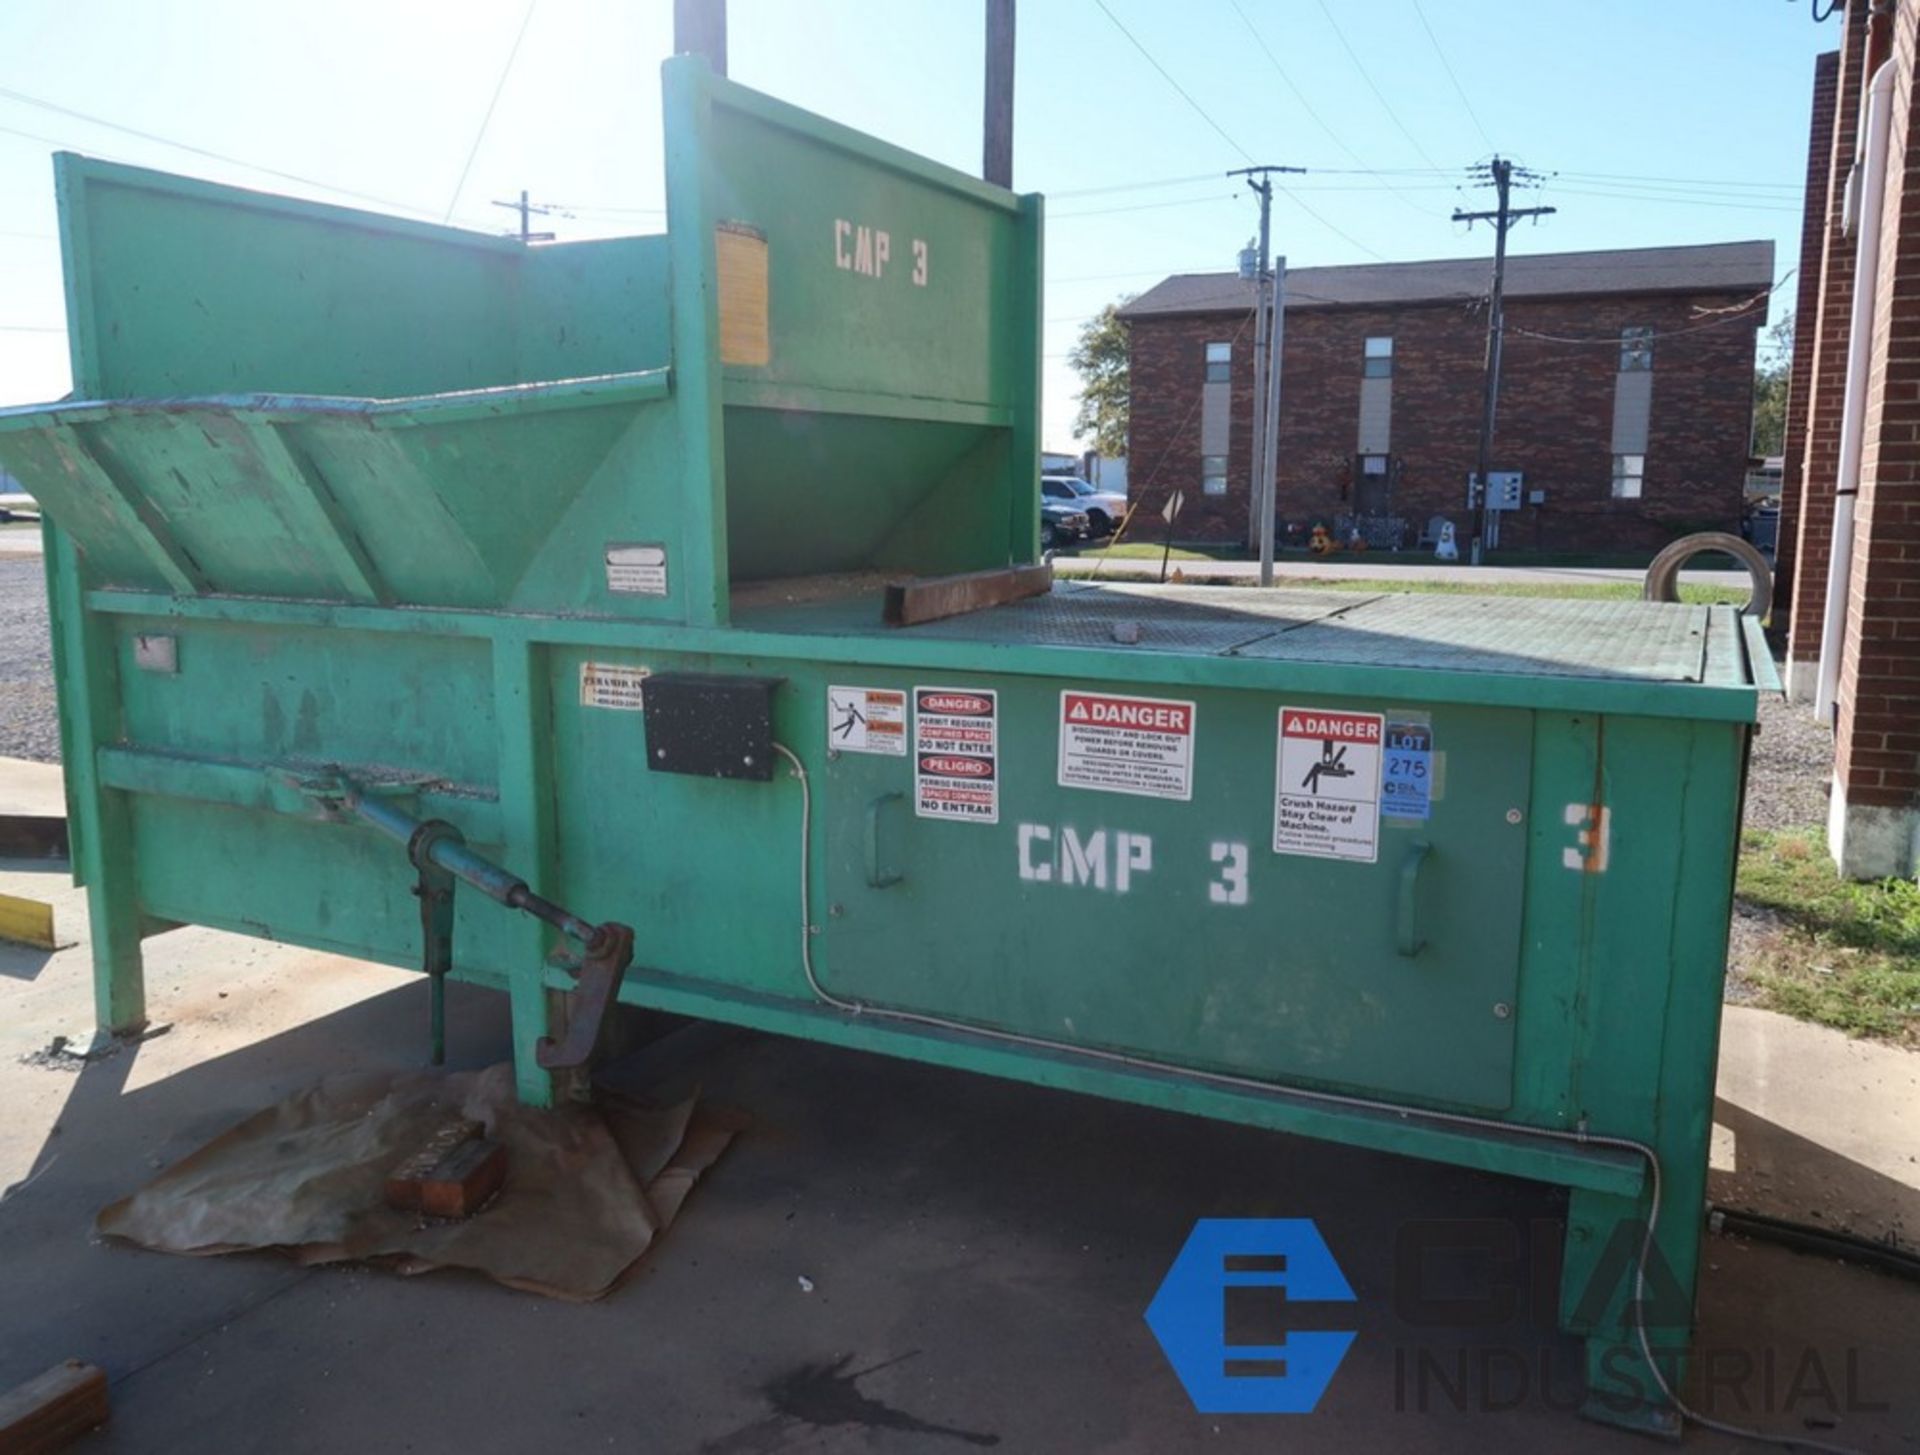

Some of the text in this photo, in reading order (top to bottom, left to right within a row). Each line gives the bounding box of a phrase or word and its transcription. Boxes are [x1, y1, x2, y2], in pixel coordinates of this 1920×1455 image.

[835, 218, 928, 286] CMP 3
[928, 698, 982, 710] DANGER
[1092, 703, 1184, 728] DANGER
[918, 717, 992, 728] PERMIT REQUIRED
[1306, 719, 1379, 738] DANGER
[921, 728, 990, 739] CONFINED SPACE
[1072, 726, 1182, 743] DISCONNECT AND LOCK OUT
[918, 740, 992, 753] DO NOT ENTER
[1074, 736, 1177, 752] POWER BEFORE REMOVING
[1391, 735, 1425, 748] LOT
[1085, 747, 1116, 755] GUARDS
[930, 759, 983, 772] PELIGRO
[1389, 758, 1426, 778] 275
[921, 801, 992, 814] NO ENTRAR
[1281, 797, 1356, 813] Crush Hazard
[1281, 809, 1352, 824] Stay Clear of
[1280, 821, 1329, 833] Machine.
[1279, 838, 1301, 846] before
[1332, 835, 1372, 845] procedures
[1563, 803, 1611, 872] 3
[1017, 822, 1249, 904] CMP 3
